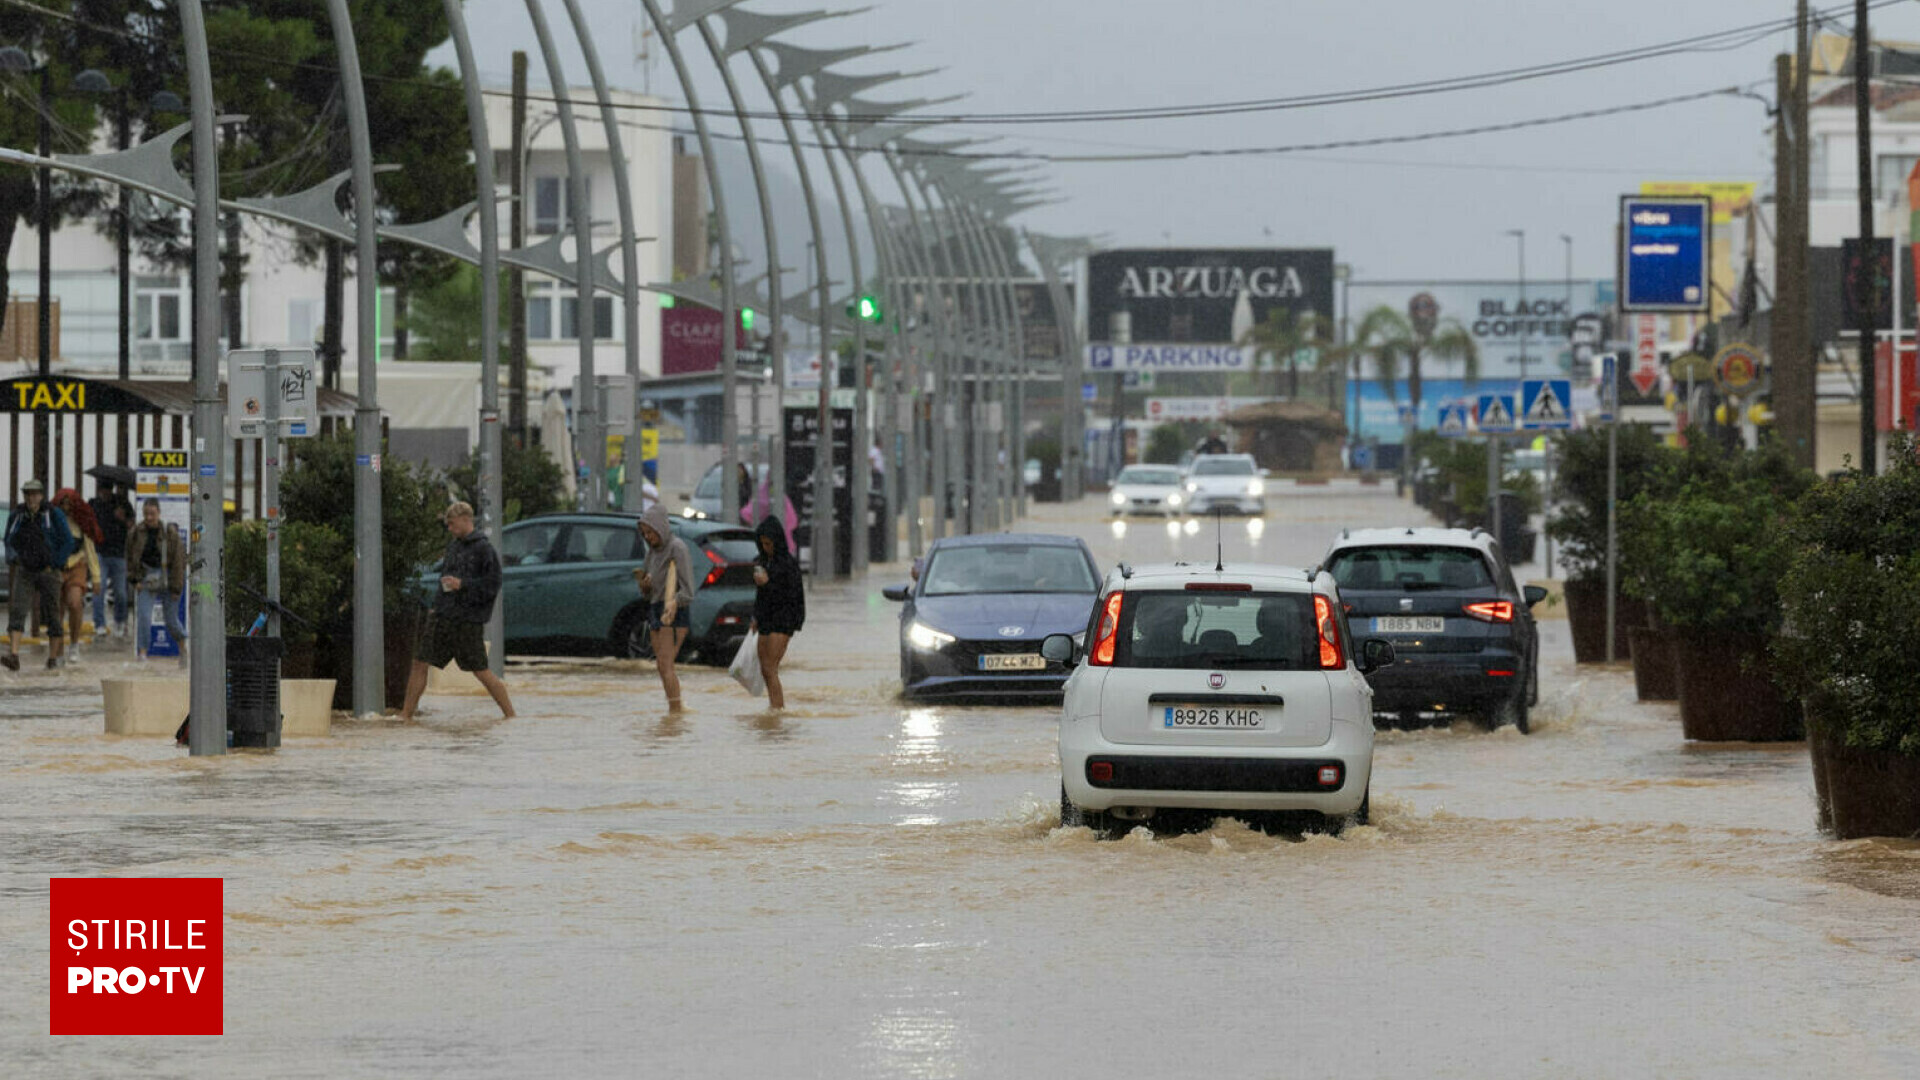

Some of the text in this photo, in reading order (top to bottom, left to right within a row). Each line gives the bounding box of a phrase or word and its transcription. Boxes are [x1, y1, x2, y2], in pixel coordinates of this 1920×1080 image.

[1119, 266, 1303, 299] ARZUAGA
[1480, 300, 1569, 316] BLACK
[1126, 348, 1243, 368] PARKING
[12, 382, 86, 410] TAXI
[142, 452, 185, 466] TAXI
[1174, 709, 1259, 727] 8926 KHC
